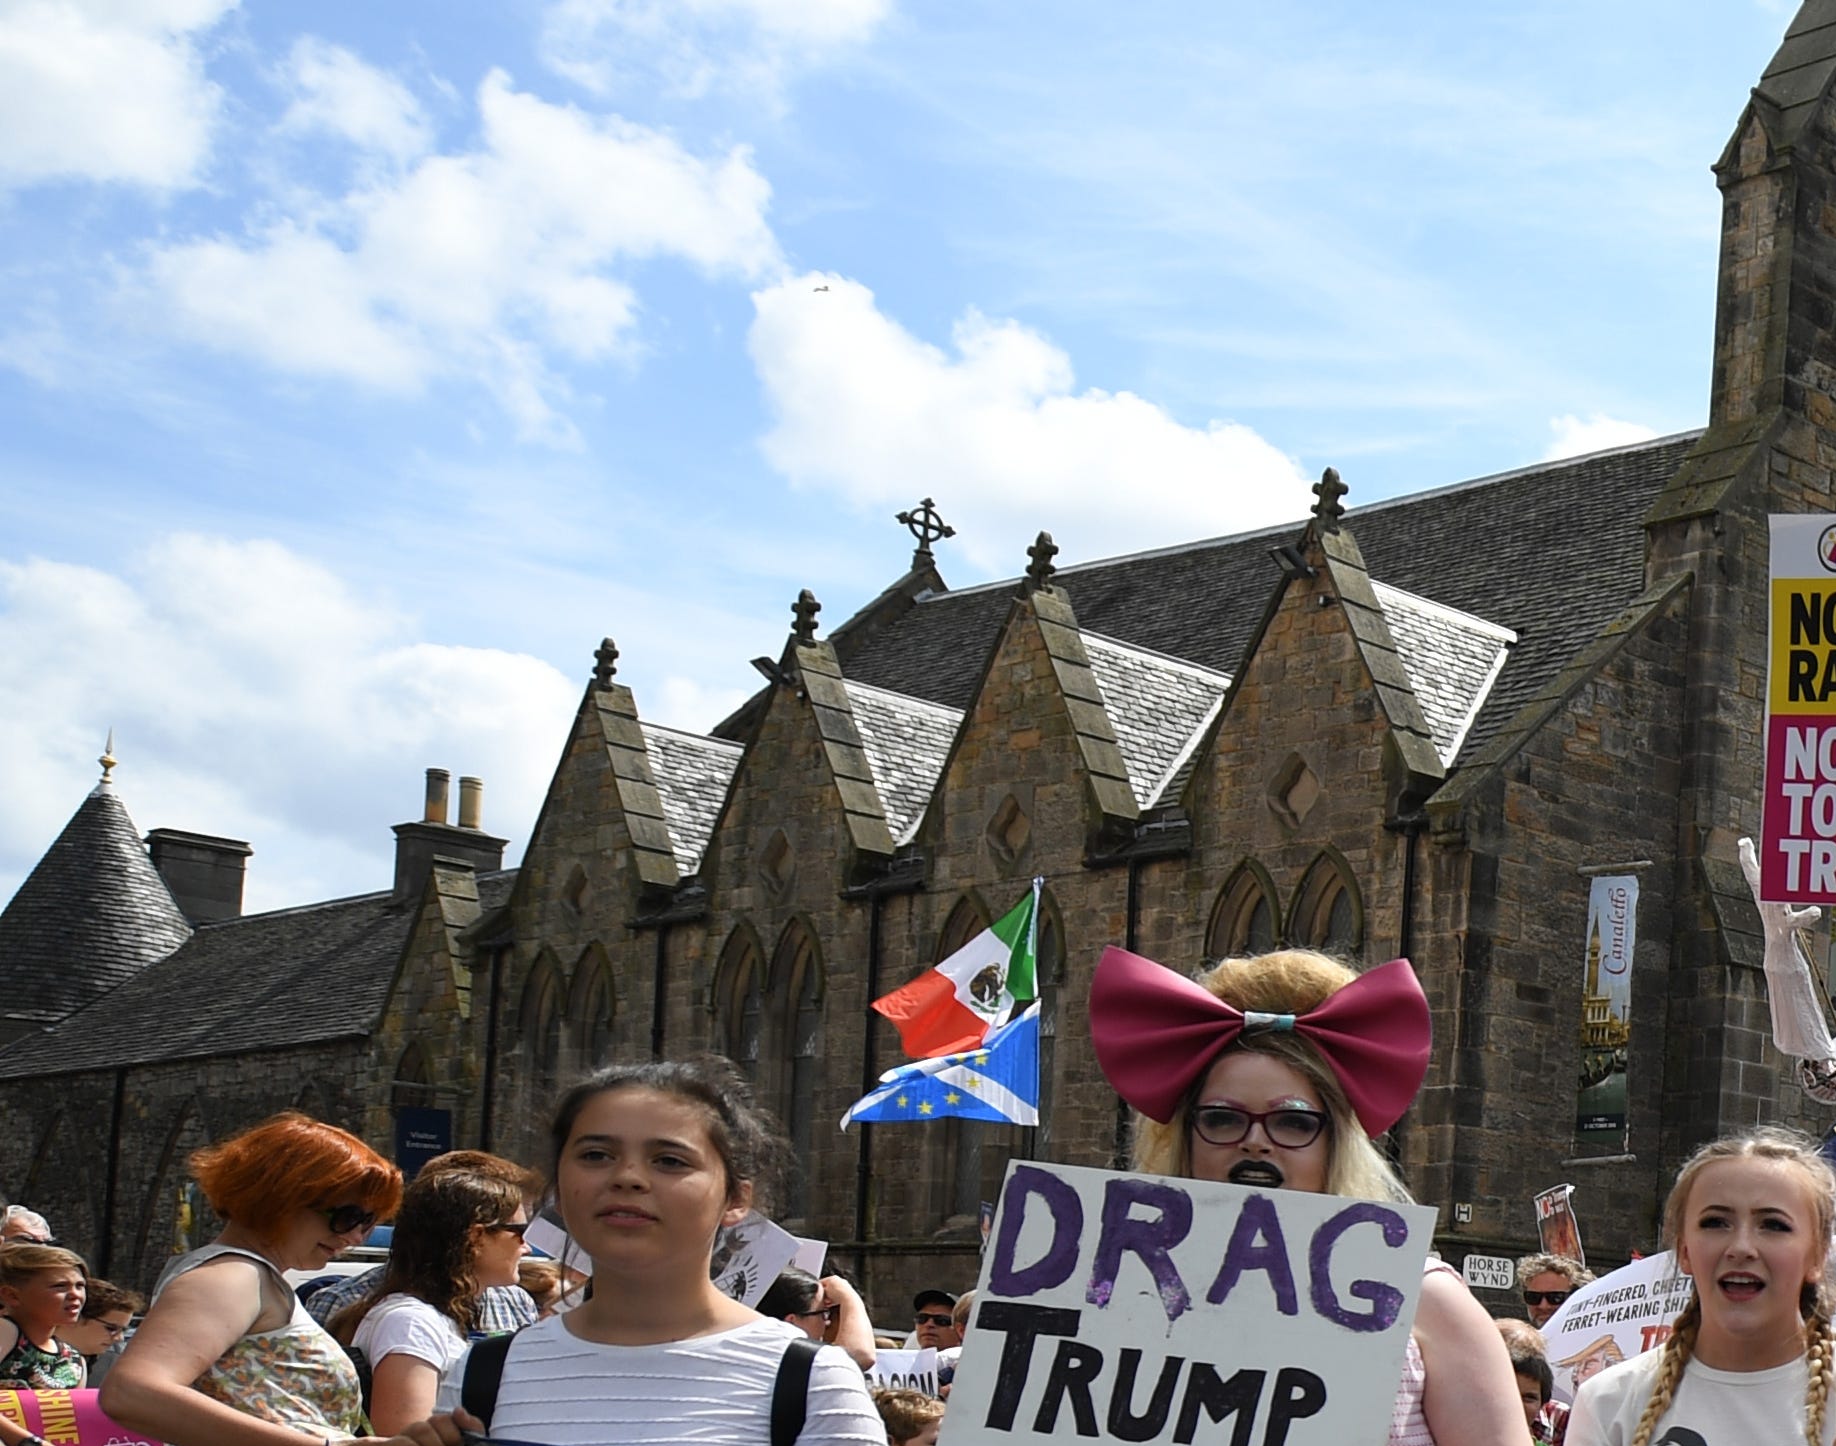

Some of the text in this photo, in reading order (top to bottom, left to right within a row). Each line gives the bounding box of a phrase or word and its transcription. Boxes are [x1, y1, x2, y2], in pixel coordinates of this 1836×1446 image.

[987, 1164, 1409, 1336] DRAG
[1468, 1256, 1509, 1273] HORSE
[1468, 1271, 1510, 1287] WYND
[1652, 1276, 1693, 1297] CHEET
[1561, 1299, 1660, 1334] FERRET-WEARING
[34, 1389, 81, 1445] SHINE
